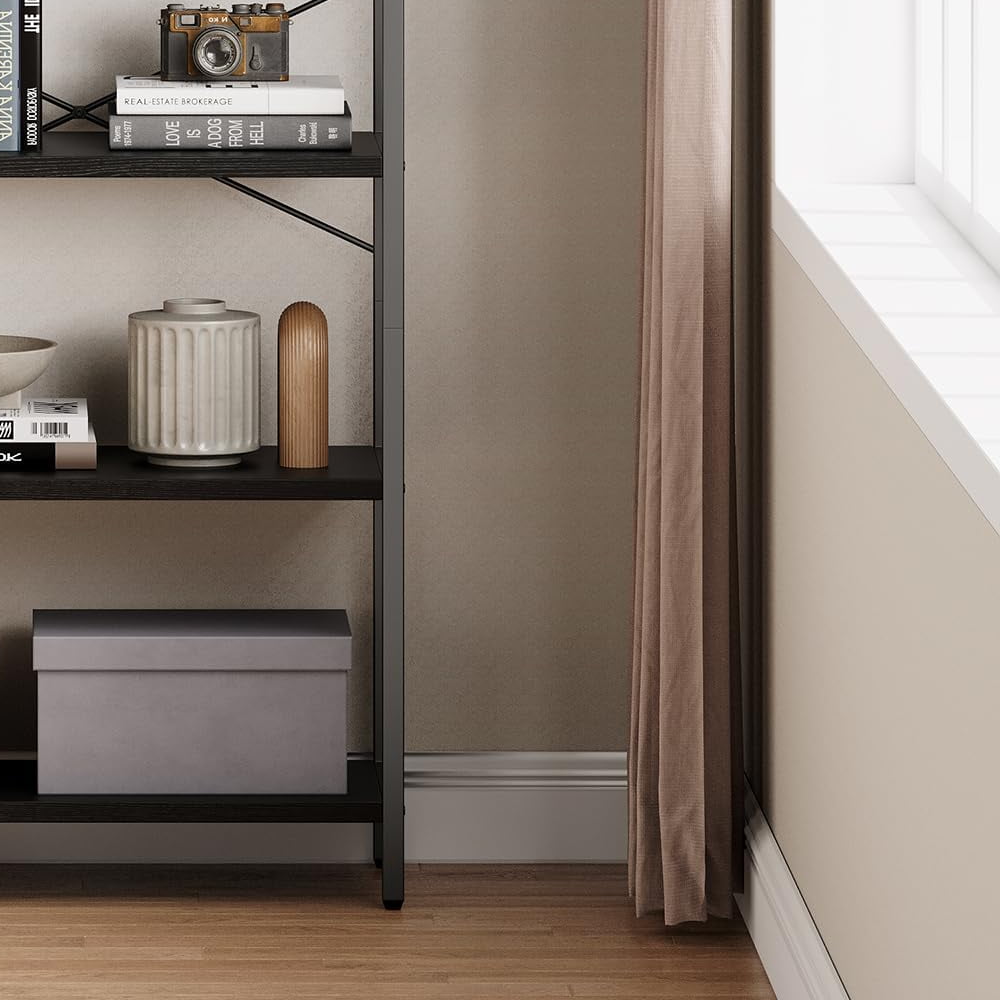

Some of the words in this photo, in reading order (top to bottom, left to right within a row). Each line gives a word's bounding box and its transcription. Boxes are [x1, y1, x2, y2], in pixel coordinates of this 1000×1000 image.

[181, 97, 233, 106] BROKERAGE
[166, 121, 180, 146] LOVE
[187, 128, 201, 139] IS
[208, 118, 222, 139] DOG
[229, 120, 243, 147] FROM
[250, 121, 264, 146] HELL
[208, 140, 222, 149] A
